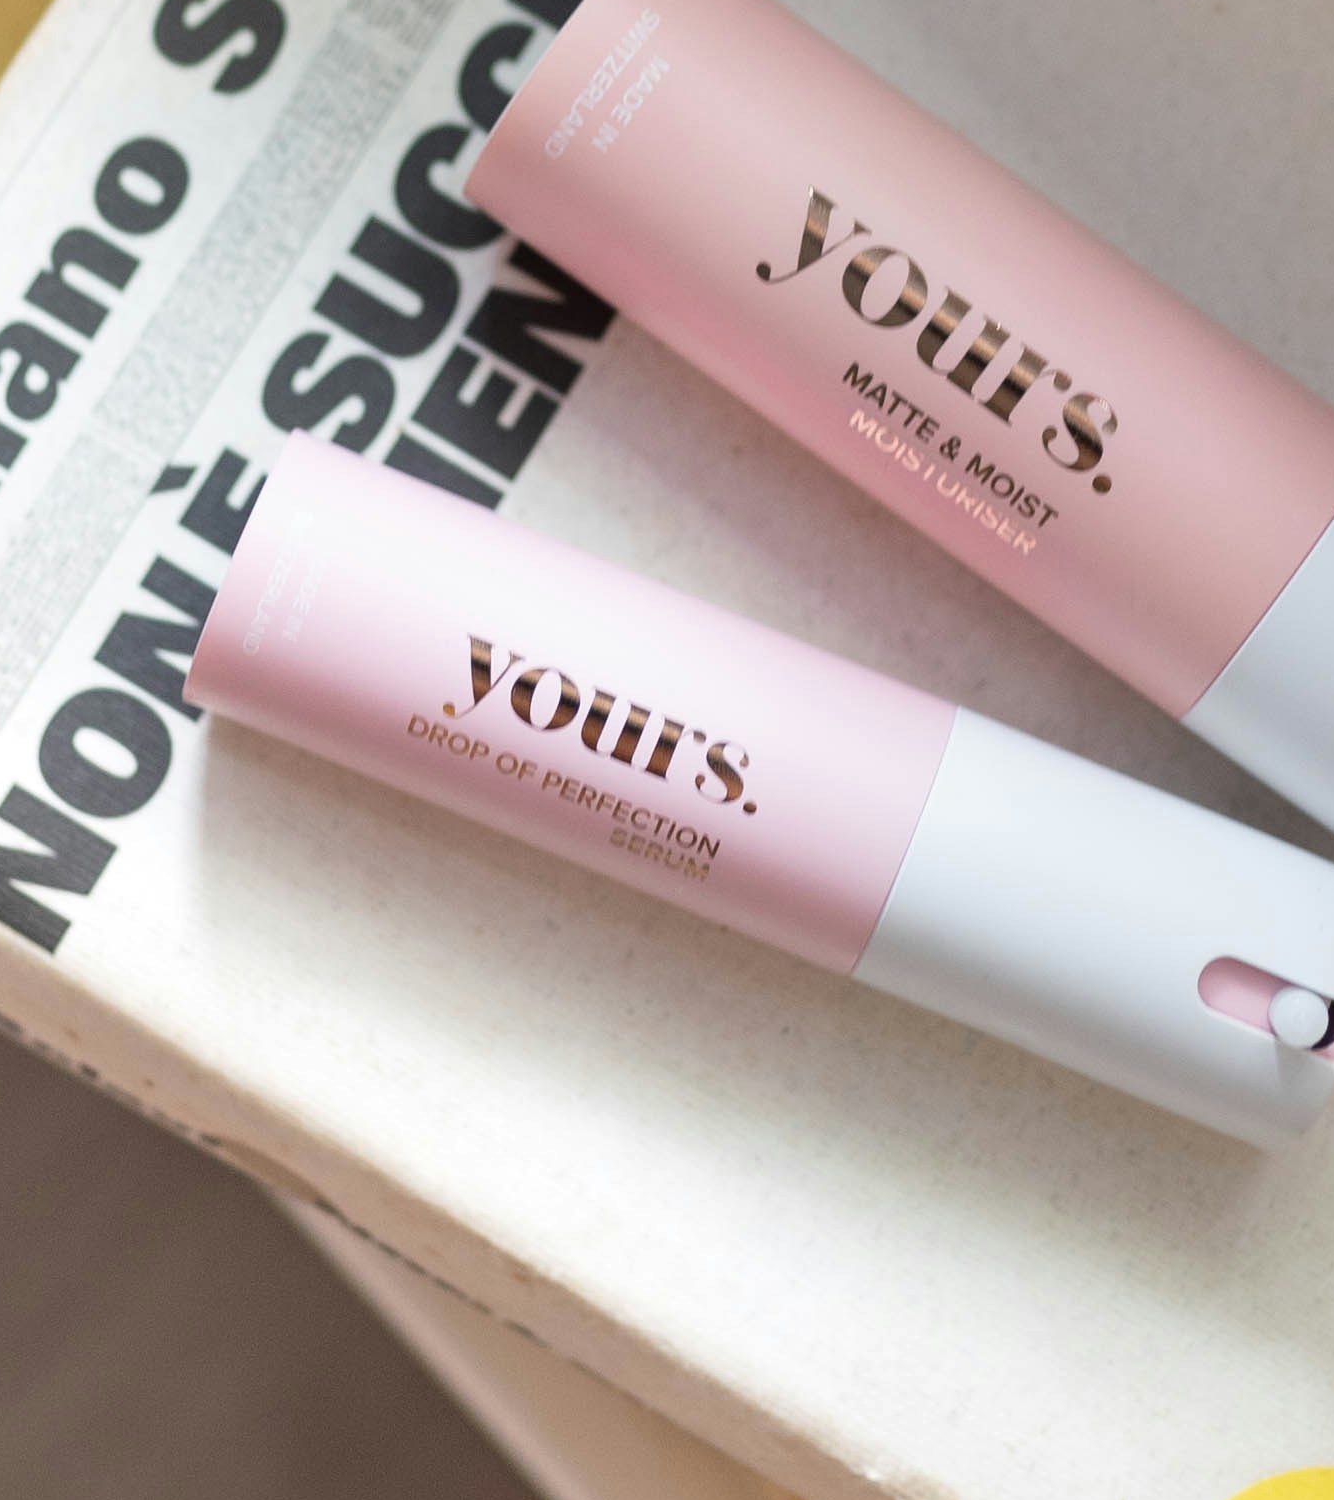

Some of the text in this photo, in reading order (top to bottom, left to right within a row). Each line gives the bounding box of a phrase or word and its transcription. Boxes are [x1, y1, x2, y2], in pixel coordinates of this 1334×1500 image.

[546, 7, 660, 159] SWITZERLAND
[591, 55, 670, 153] MADE IN
[755, 186, 1118, 495] yours.
[843, 363, 1057, 527] MATTE & MOIST
[847, 409, 1040, 556] MOISTURISER
[407, 716, 720, 860] DROP OF PERFECTION
[443, 636, 757, 815] yours.
[610, 829, 710, 881] SERUM
